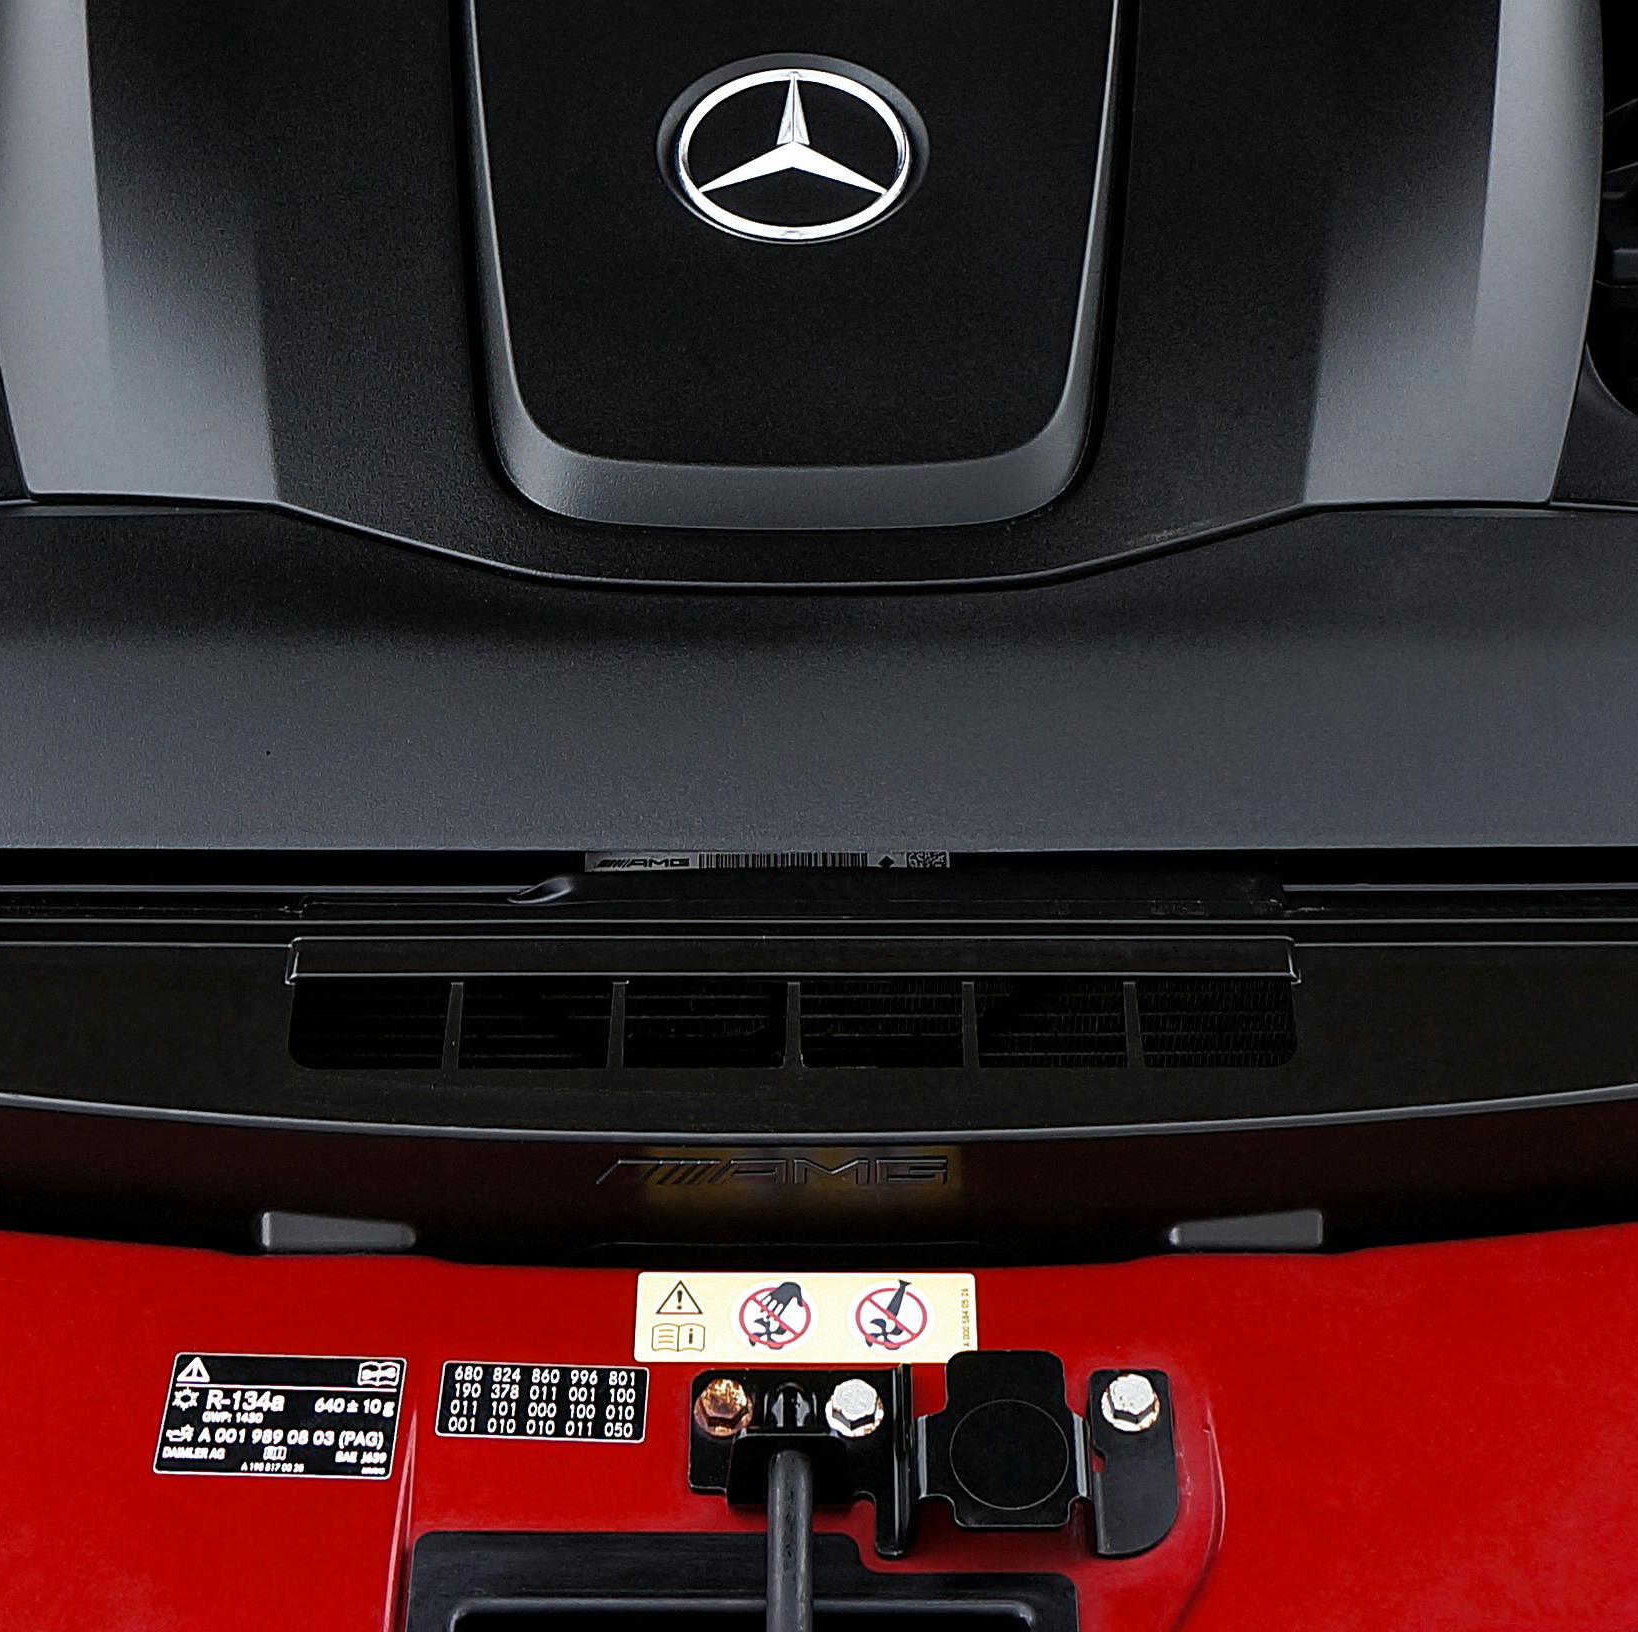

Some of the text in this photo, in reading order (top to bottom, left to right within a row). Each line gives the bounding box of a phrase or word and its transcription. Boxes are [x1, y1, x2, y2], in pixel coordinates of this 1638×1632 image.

[626, 857, 690, 868] AMG
[454, 1366, 636, 1386] 680 824 860 996 801
[205, 1389, 286, 1412] R-134a
[314, 1397, 345, 1414] 640
[363, 1398, 381, 1414] 10
[454, 1382, 636, 1403] 190 378 011 001 100
[450, 1399, 635, 1421] 011 101 000 100 010
[197, 1426, 384, 1449] A 001 989 08 03 (PAG)
[447, 1416, 634, 1438] 001 010 010 011 050
[162, 1446, 226, 1461] DAIMLER AG
